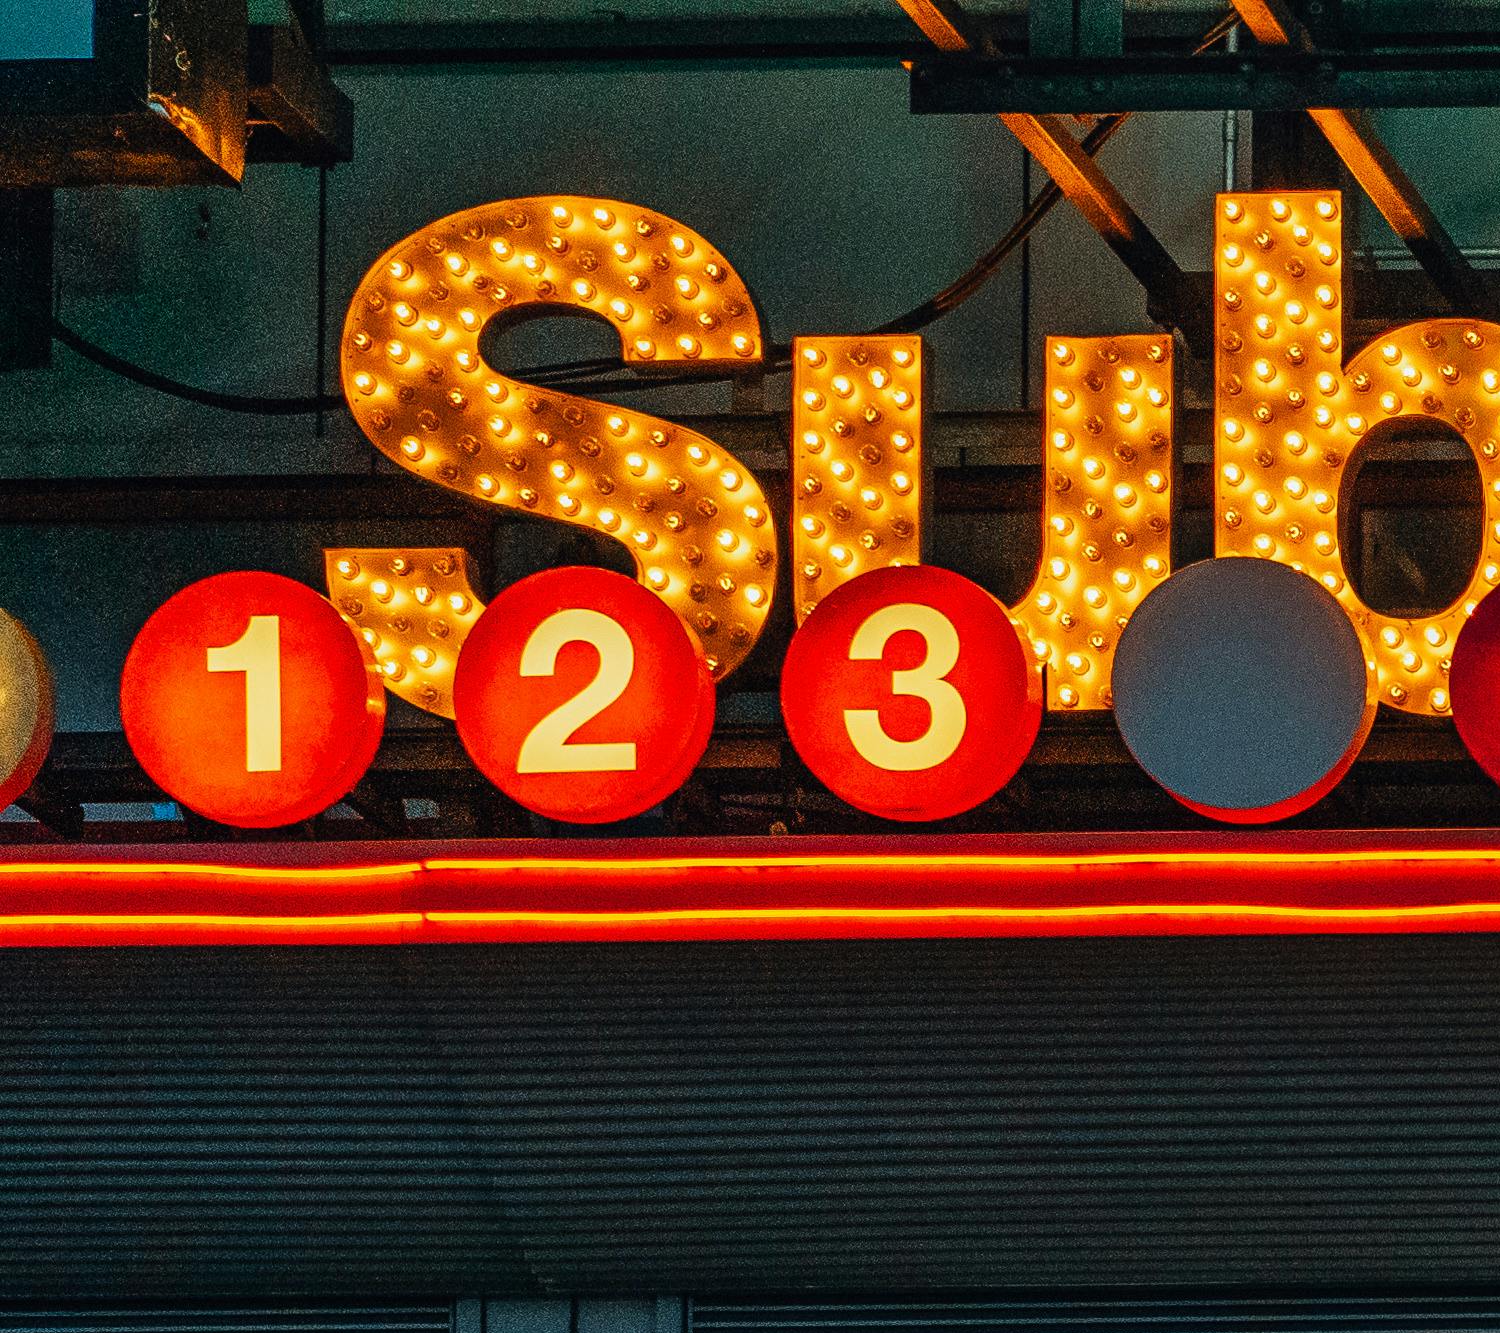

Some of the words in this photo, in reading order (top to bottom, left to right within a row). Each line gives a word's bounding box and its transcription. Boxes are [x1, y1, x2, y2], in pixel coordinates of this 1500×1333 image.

[207, 616, 281, 772] 1
[517, 609, 638, 773] 2
[842, 604, 968, 771] 3
